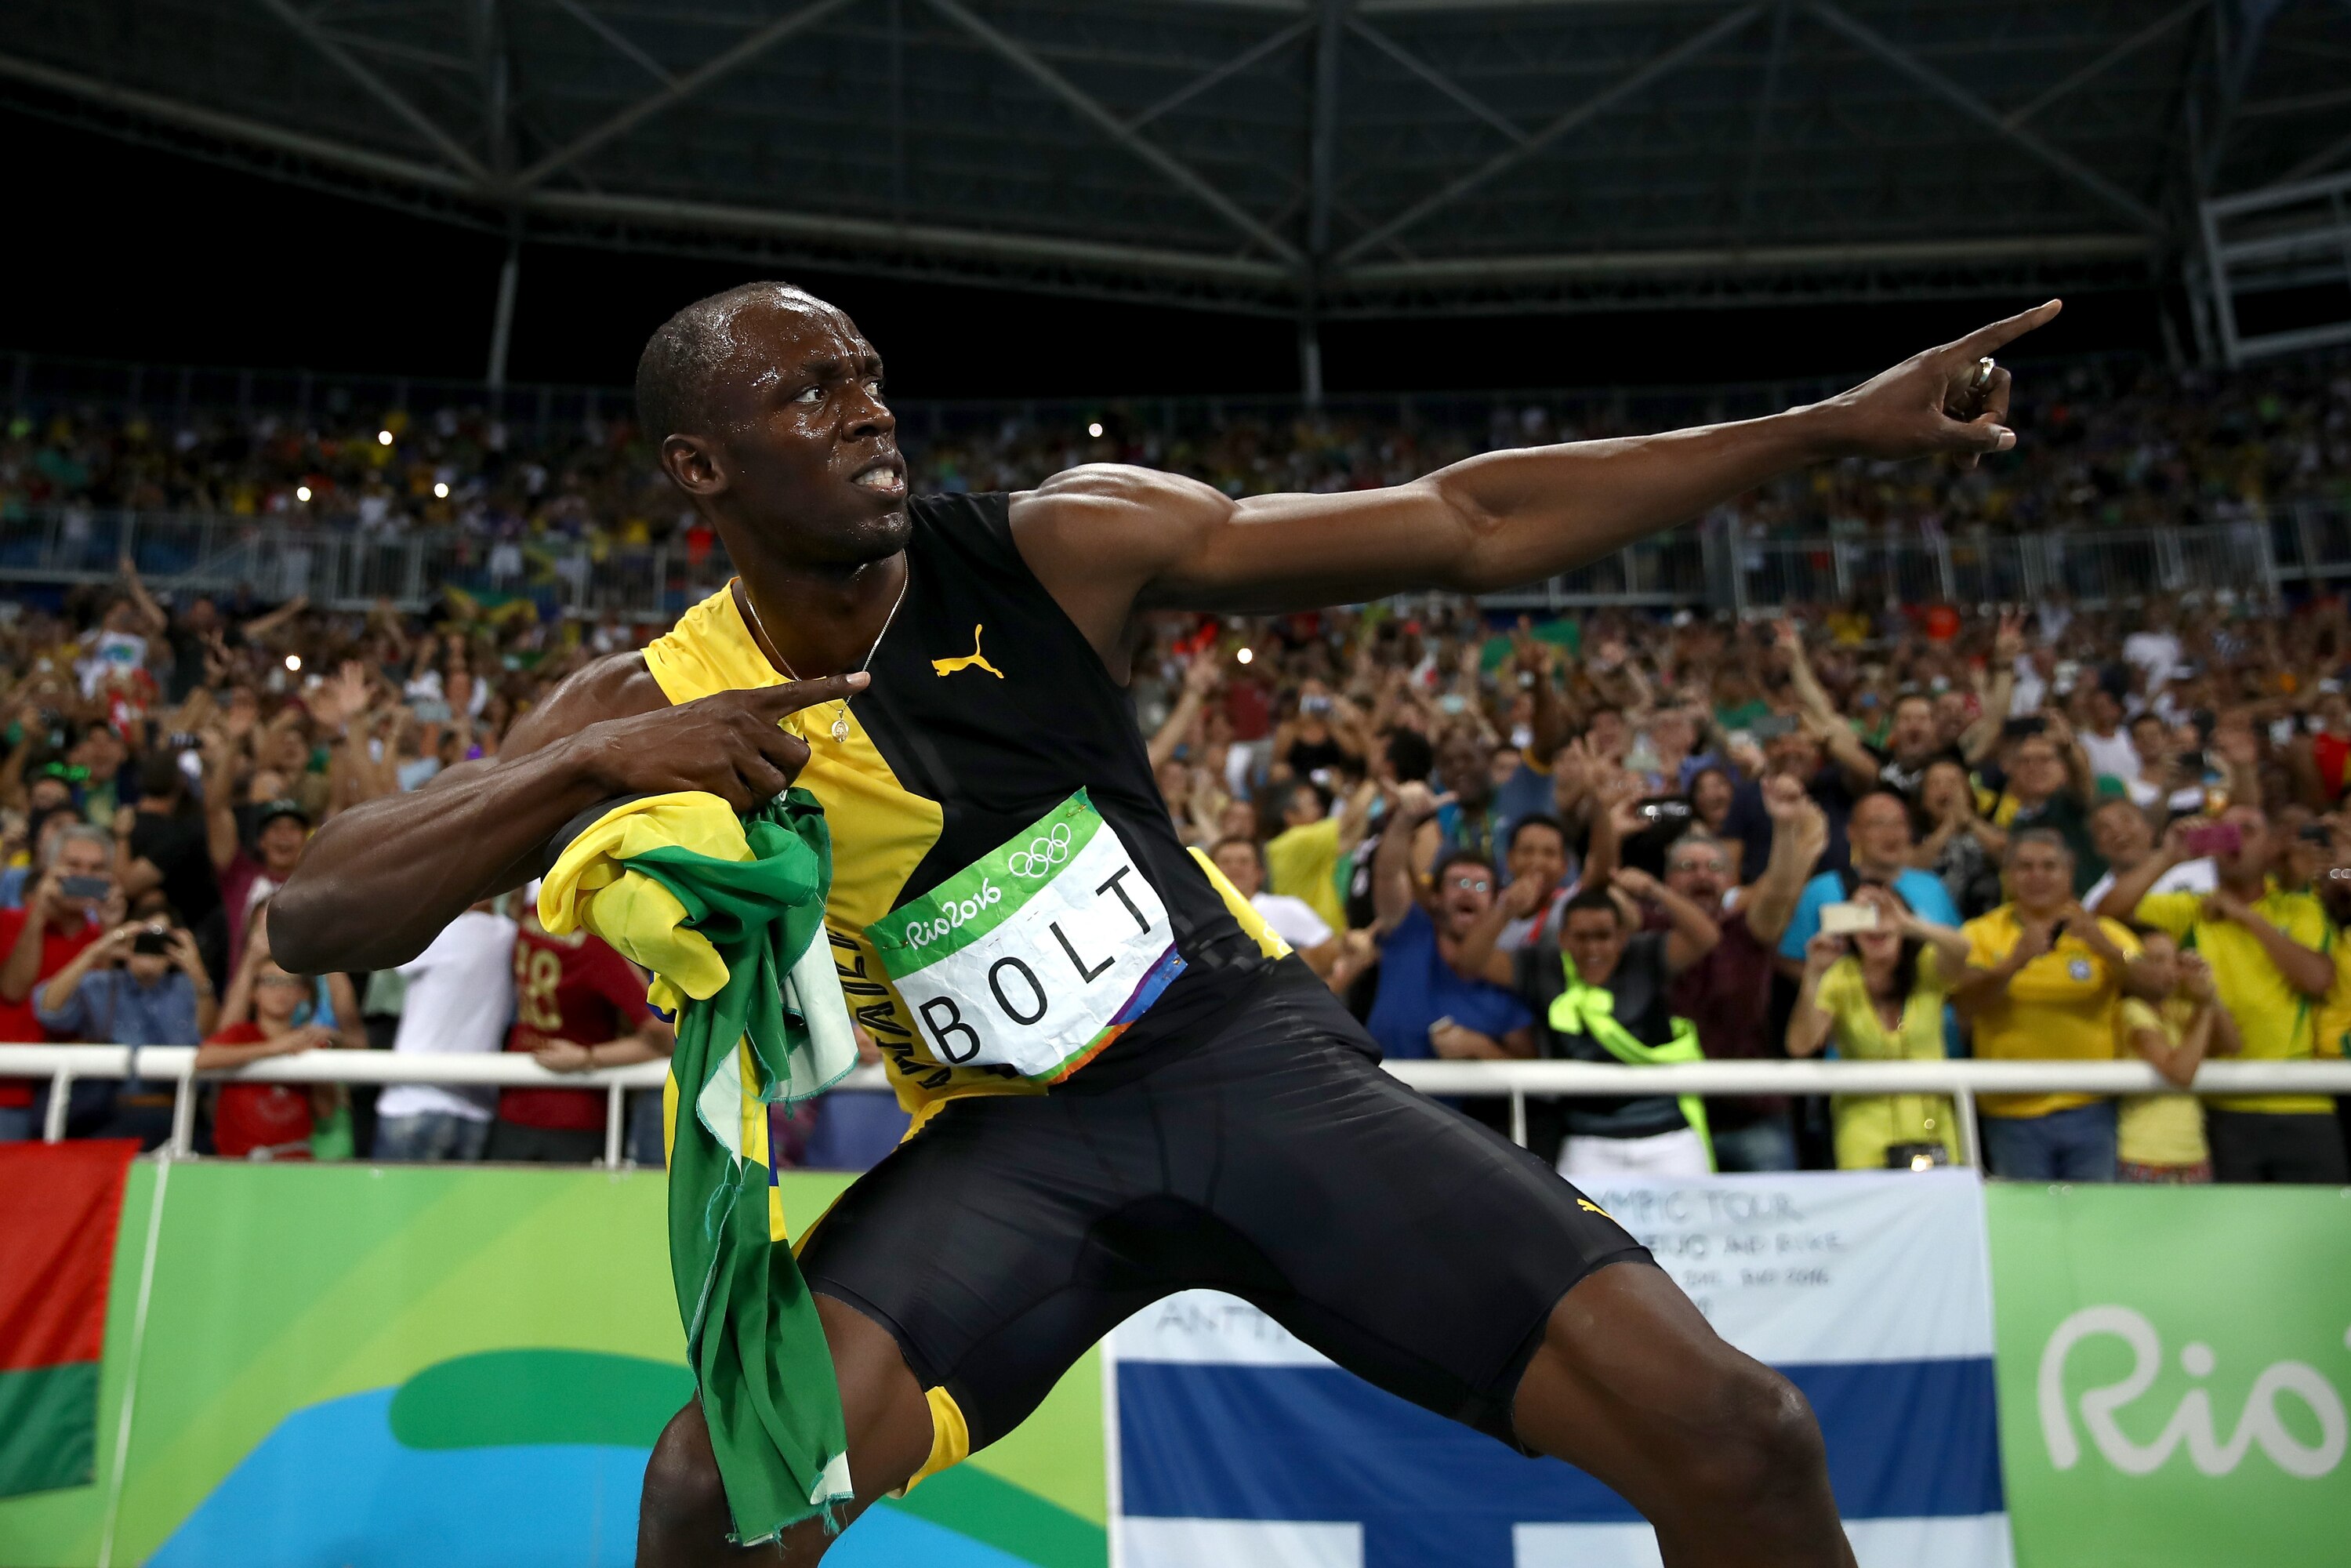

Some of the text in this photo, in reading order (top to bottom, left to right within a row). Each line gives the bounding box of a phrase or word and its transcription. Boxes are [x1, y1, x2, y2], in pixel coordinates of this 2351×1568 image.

[918, 865, 1151, 1065] BOLT
[1698, 1189, 1805, 1225] TOUR
[2037, 1301, 2351, 1480] Rio
